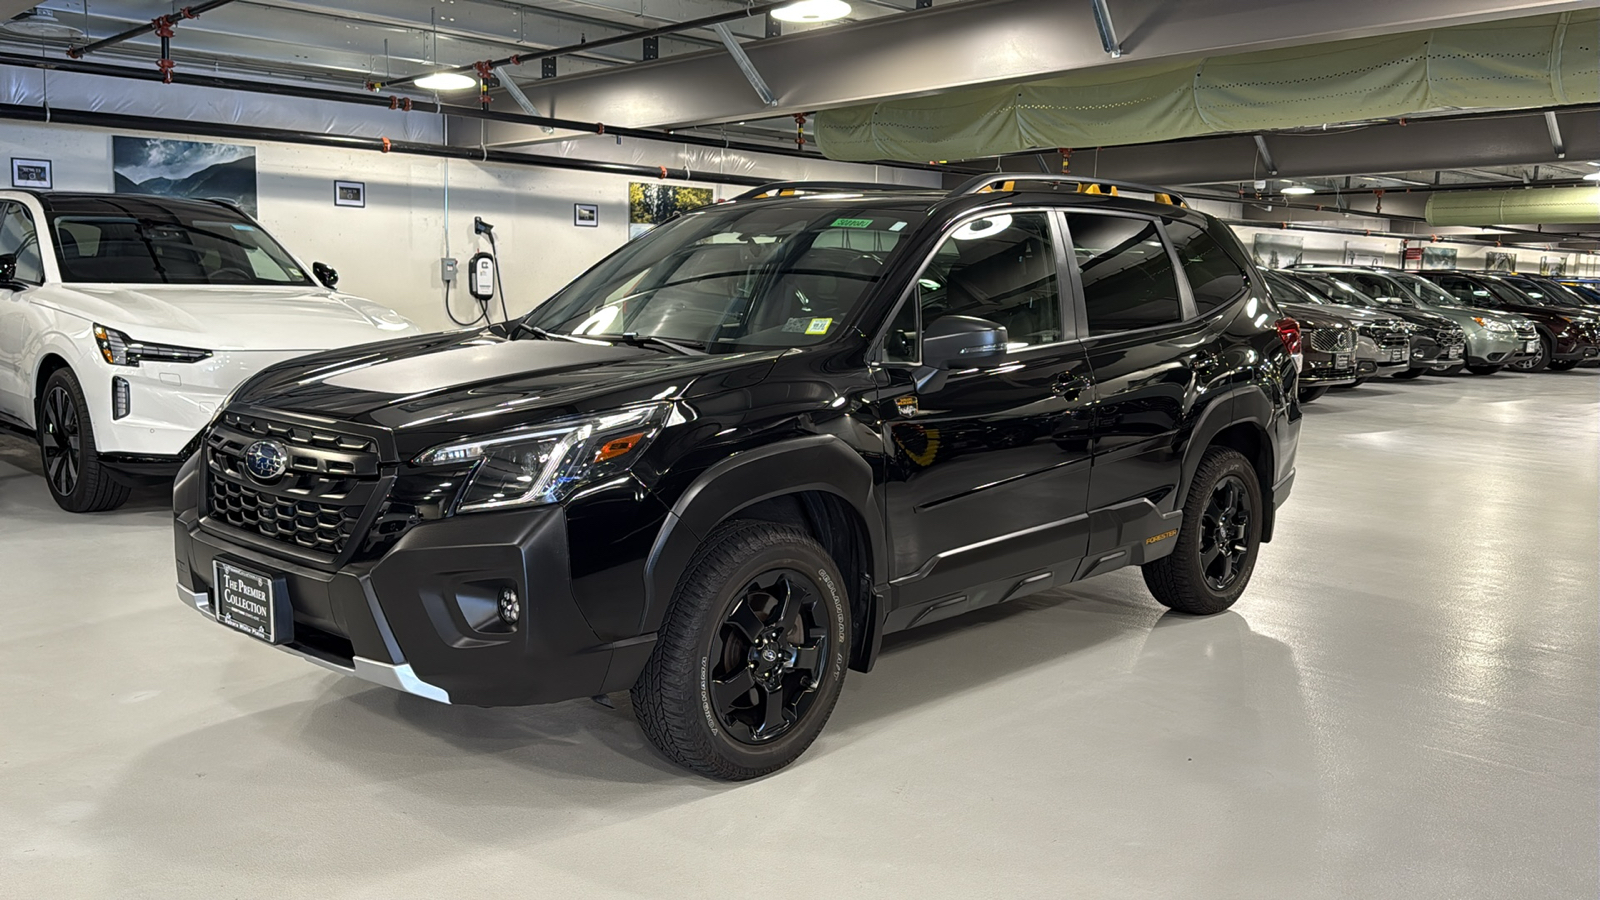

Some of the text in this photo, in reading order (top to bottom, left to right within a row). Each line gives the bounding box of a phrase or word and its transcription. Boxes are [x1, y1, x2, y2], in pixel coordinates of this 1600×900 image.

[223, 574, 267, 602] THE PREMIER
[224, 589, 267, 617] COLLECTION
[818, 568, 845, 643] GEOLANDAR
[701, 656, 718, 737] YOKOHAMA
